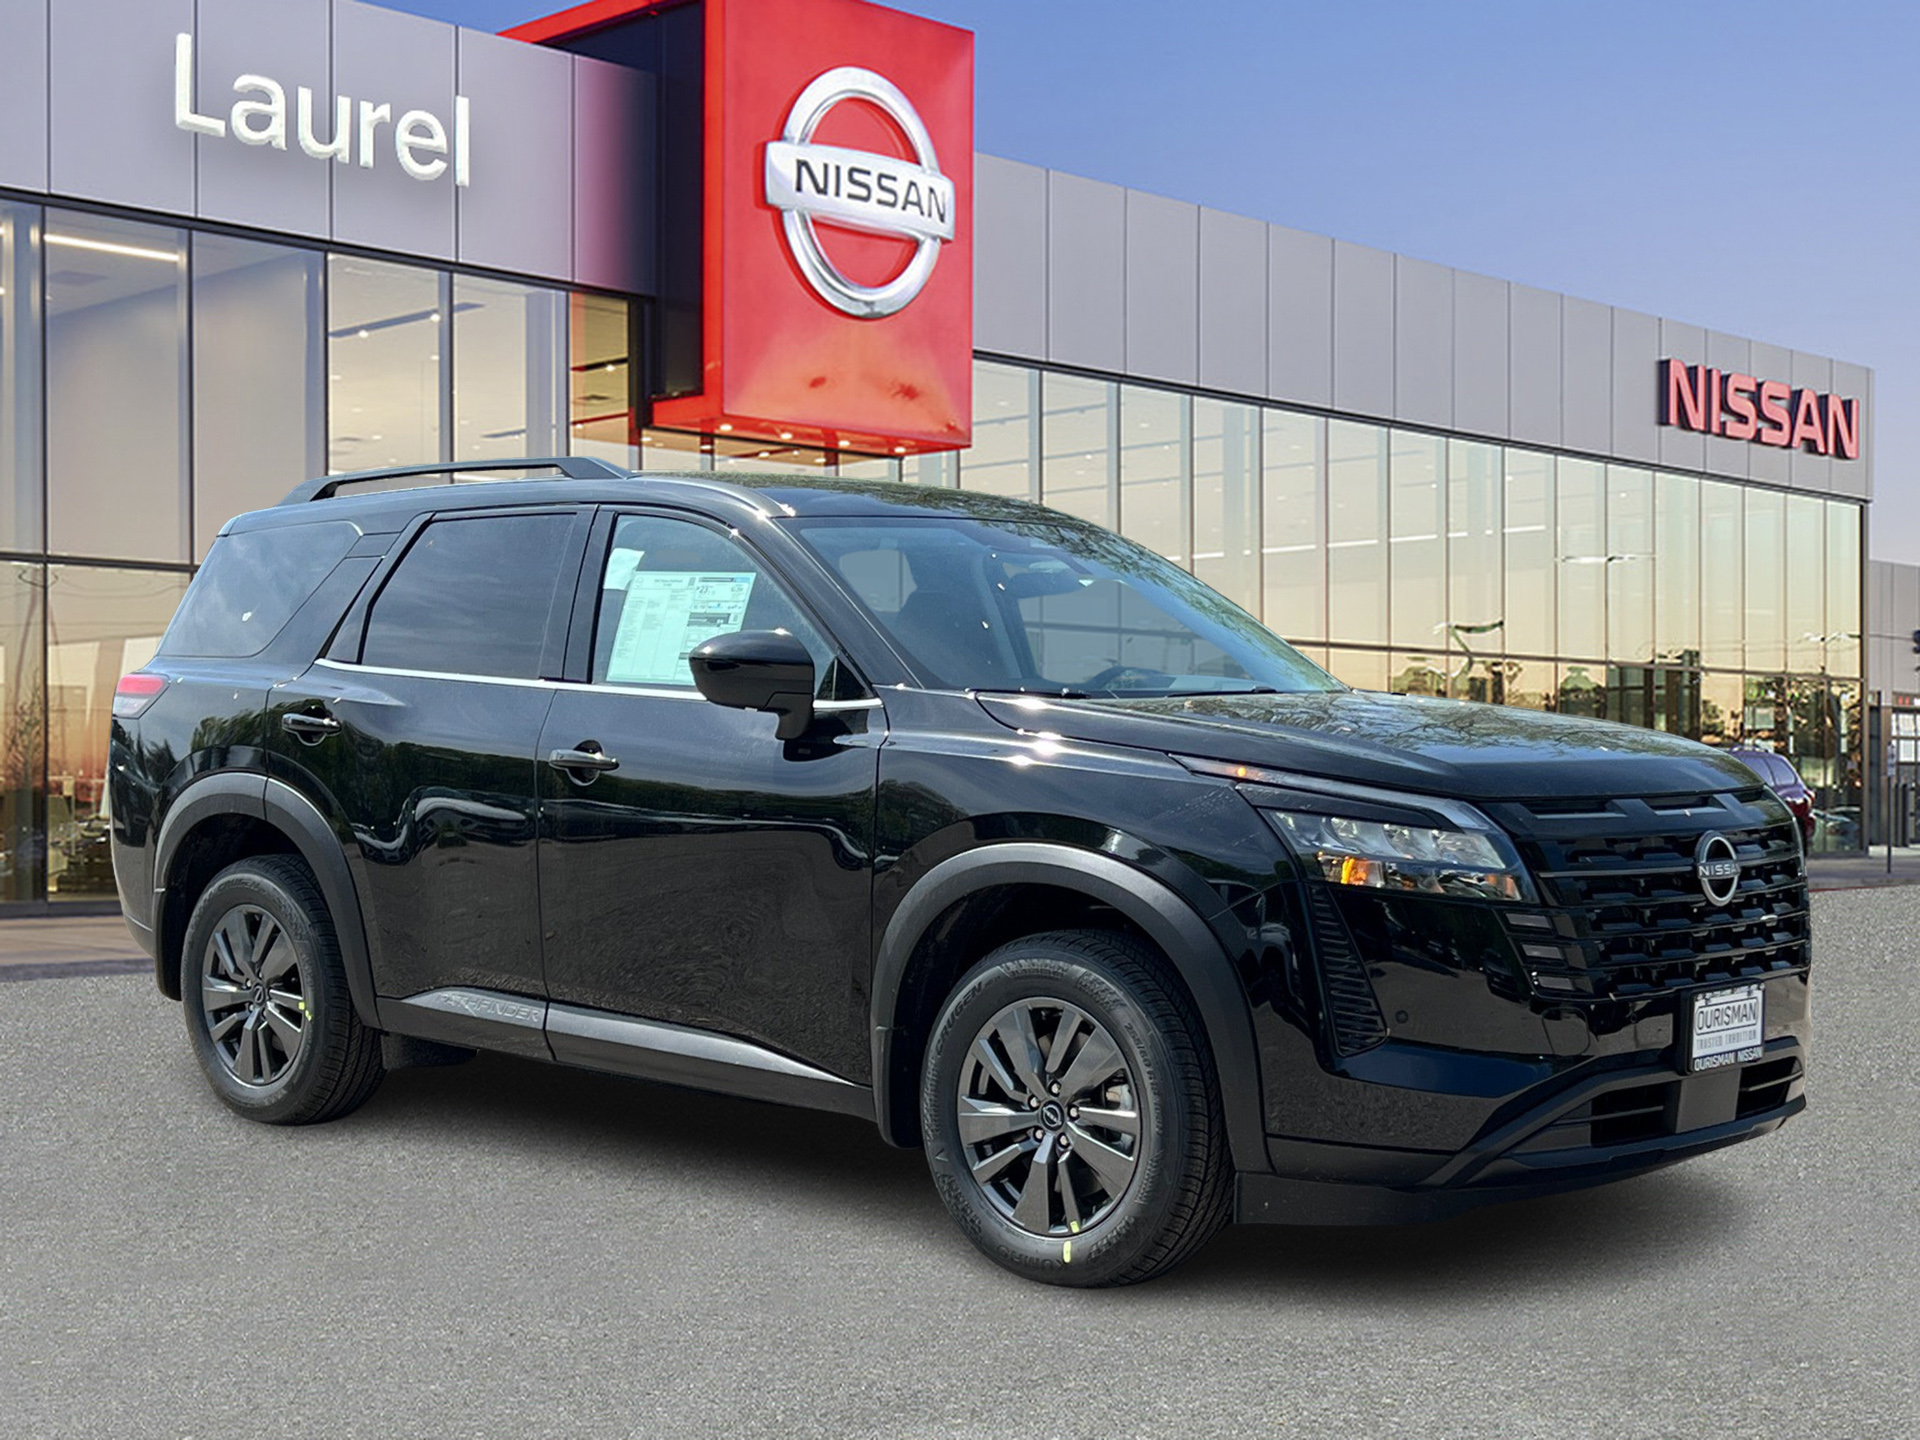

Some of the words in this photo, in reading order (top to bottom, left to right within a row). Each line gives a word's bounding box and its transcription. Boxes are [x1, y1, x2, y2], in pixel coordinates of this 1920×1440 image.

[175, 33, 470, 187] Laurel
[795, 158, 946, 224] NISSAN
[1658, 358, 1860, 460] NISSAN
[436, 993, 540, 1022] PATHFINDER
[1697, 1002, 1758, 1031] OURISMAN
[1694, 1052, 1736, 1072] OURISMAN
